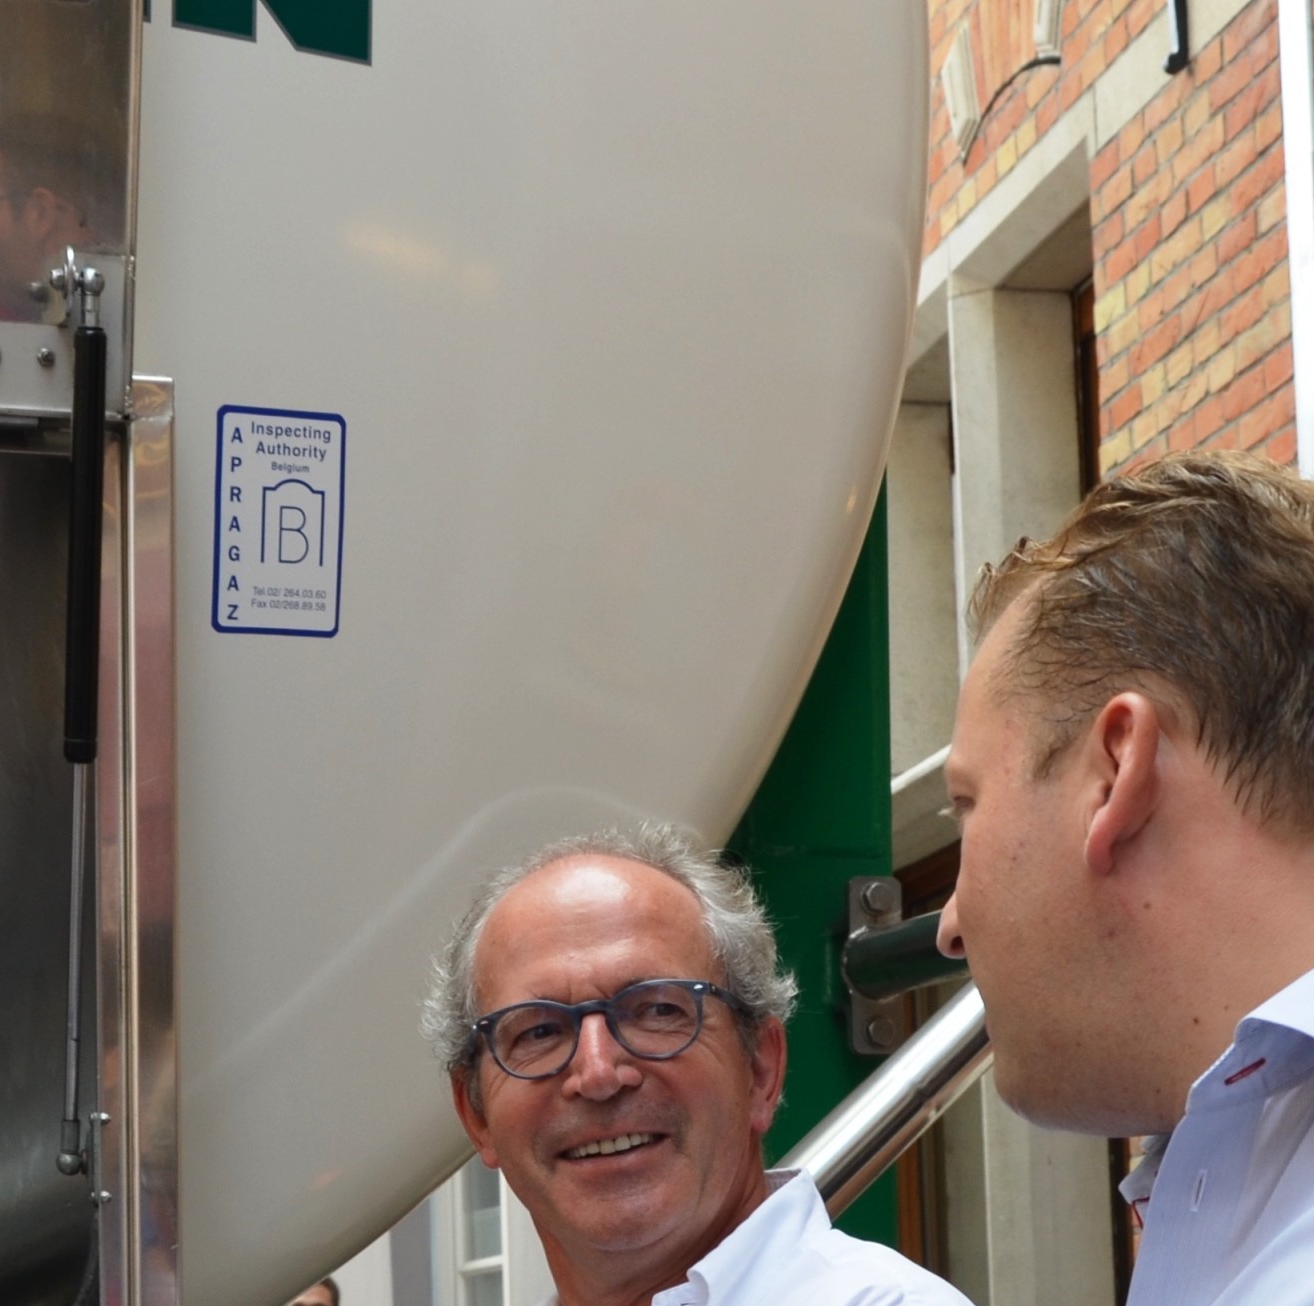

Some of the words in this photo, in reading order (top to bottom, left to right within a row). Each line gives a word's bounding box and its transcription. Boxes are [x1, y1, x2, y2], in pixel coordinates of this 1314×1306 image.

[251, 421, 331, 444] Inspecting
[255, 441, 327, 462] Authority
[271, 461, 310, 473] Belgium
[226, 426, 244, 621] APRAGAZ
[250, 598, 267, 609] Fax
